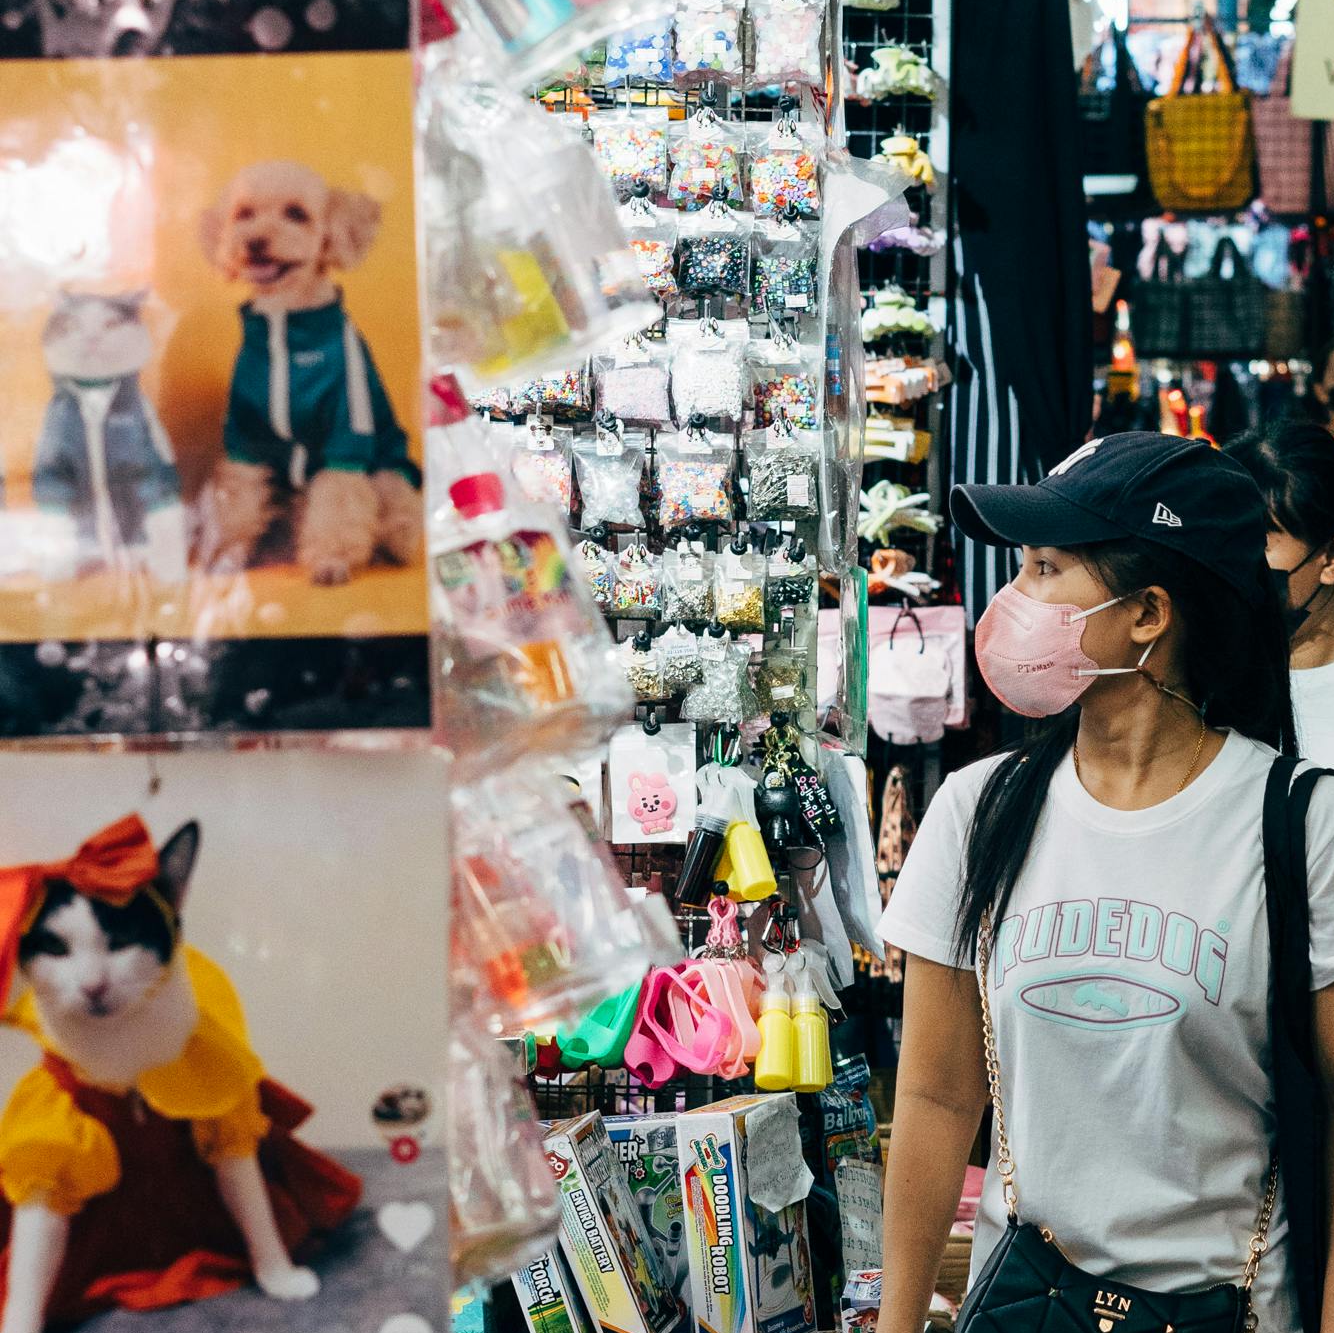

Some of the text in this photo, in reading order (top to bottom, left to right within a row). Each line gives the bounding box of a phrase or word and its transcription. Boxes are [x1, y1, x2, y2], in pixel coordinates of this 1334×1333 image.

[570, 1188, 594, 1230] ENVIRO
[585, 1228, 615, 1274] BATTERY
[709, 1173, 734, 1295] DOODLING ROBOT
[529, 1259, 557, 1305] TORCH
[1095, 1290, 1132, 1312] LYN
